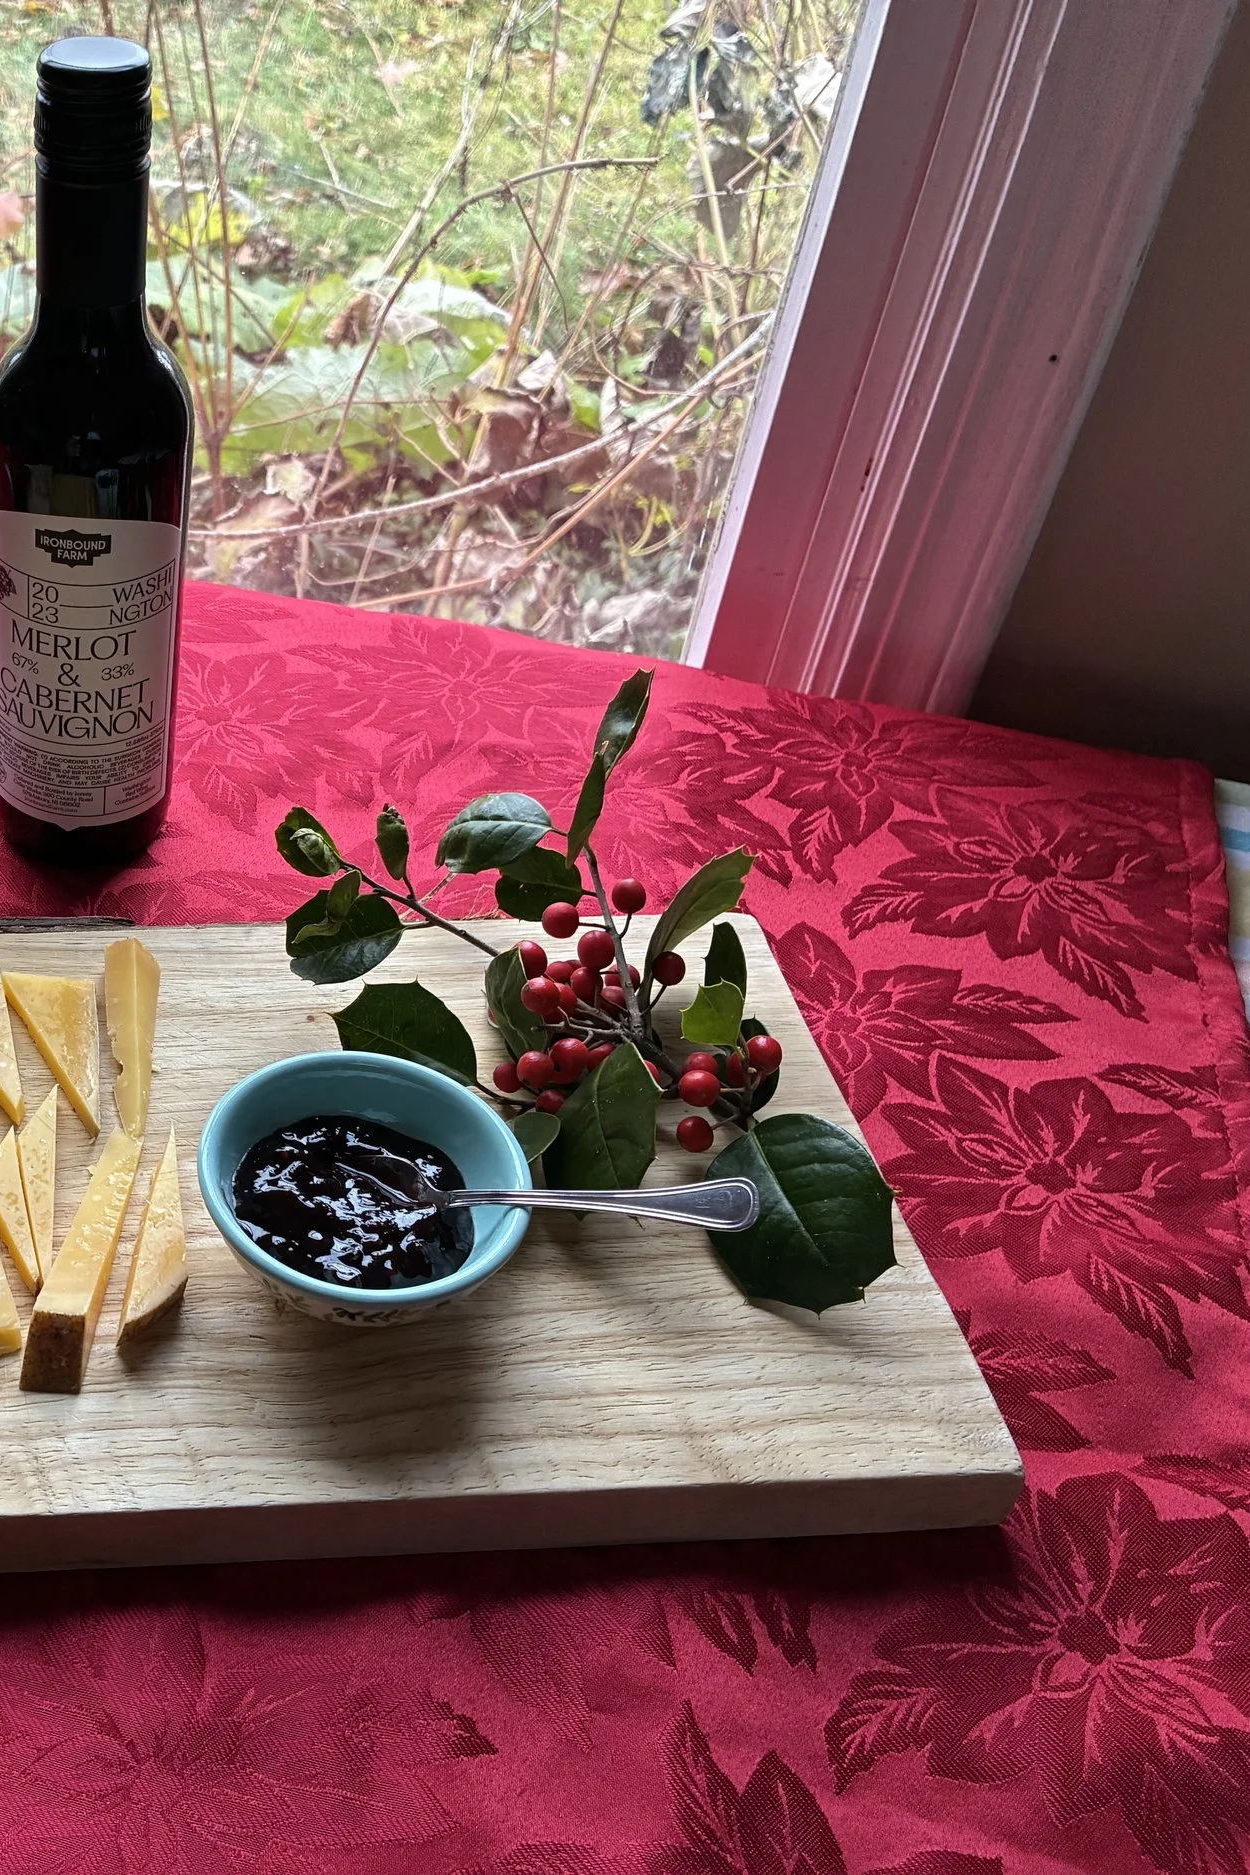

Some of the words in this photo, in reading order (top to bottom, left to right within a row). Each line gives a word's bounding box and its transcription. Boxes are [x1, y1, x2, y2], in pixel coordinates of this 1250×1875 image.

[40, 535, 106, 551] IRONBOUND
[57, 550, 88, 561] FARM
[31, 582, 59, 603] 20
[113, 567, 172, 604] WASHI
[31, 602, 59, 624] 23
[109, 587, 173, 625] NGTON
[11, 619, 137, 661] MERLOT
[11, 652, 39, 675] 67%
[57, 662, 82, 687] &
[101, 663, 135, 681] 33%
[0, 667, 150, 714] CABERNET
